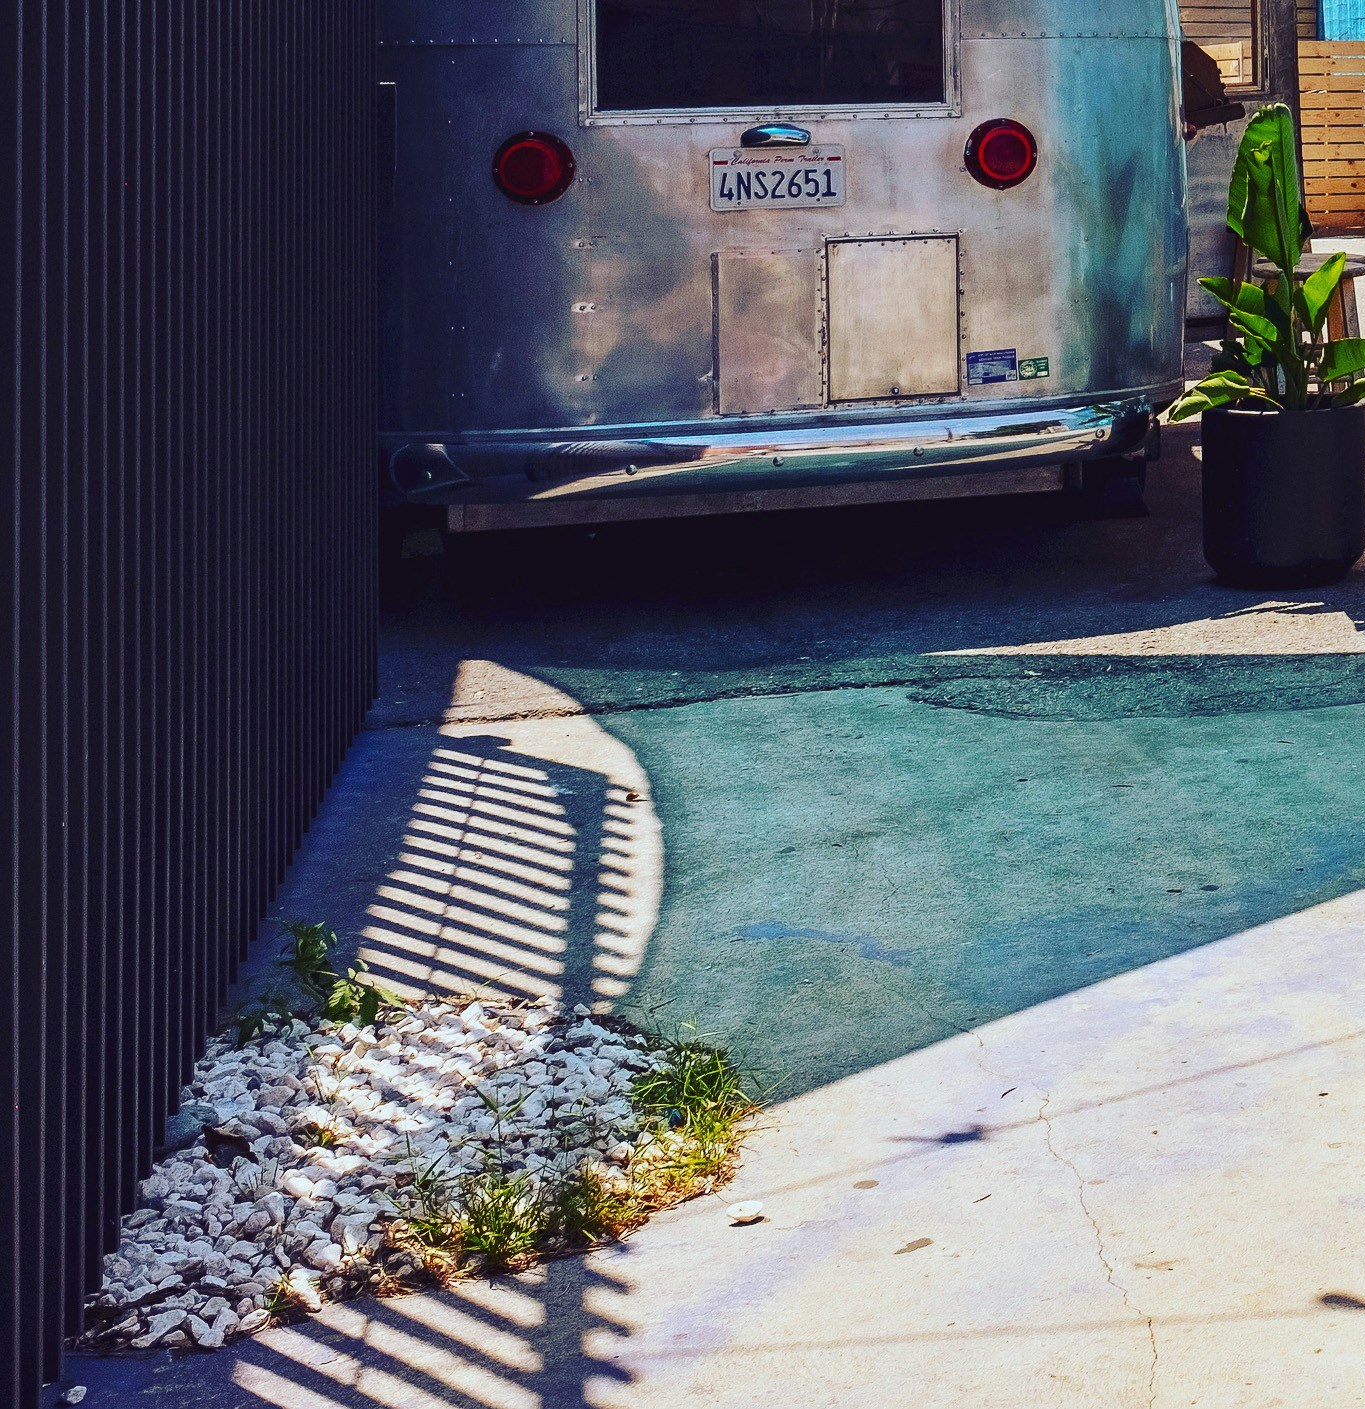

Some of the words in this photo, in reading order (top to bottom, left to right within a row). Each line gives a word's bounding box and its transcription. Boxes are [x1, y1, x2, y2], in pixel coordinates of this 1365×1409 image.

[731, 157, 770, 166] California
[773, 155, 795, 164] Perm
[798, 154, 825, 163] Trailer
[719, 168, 837, 201] 4NS2651
